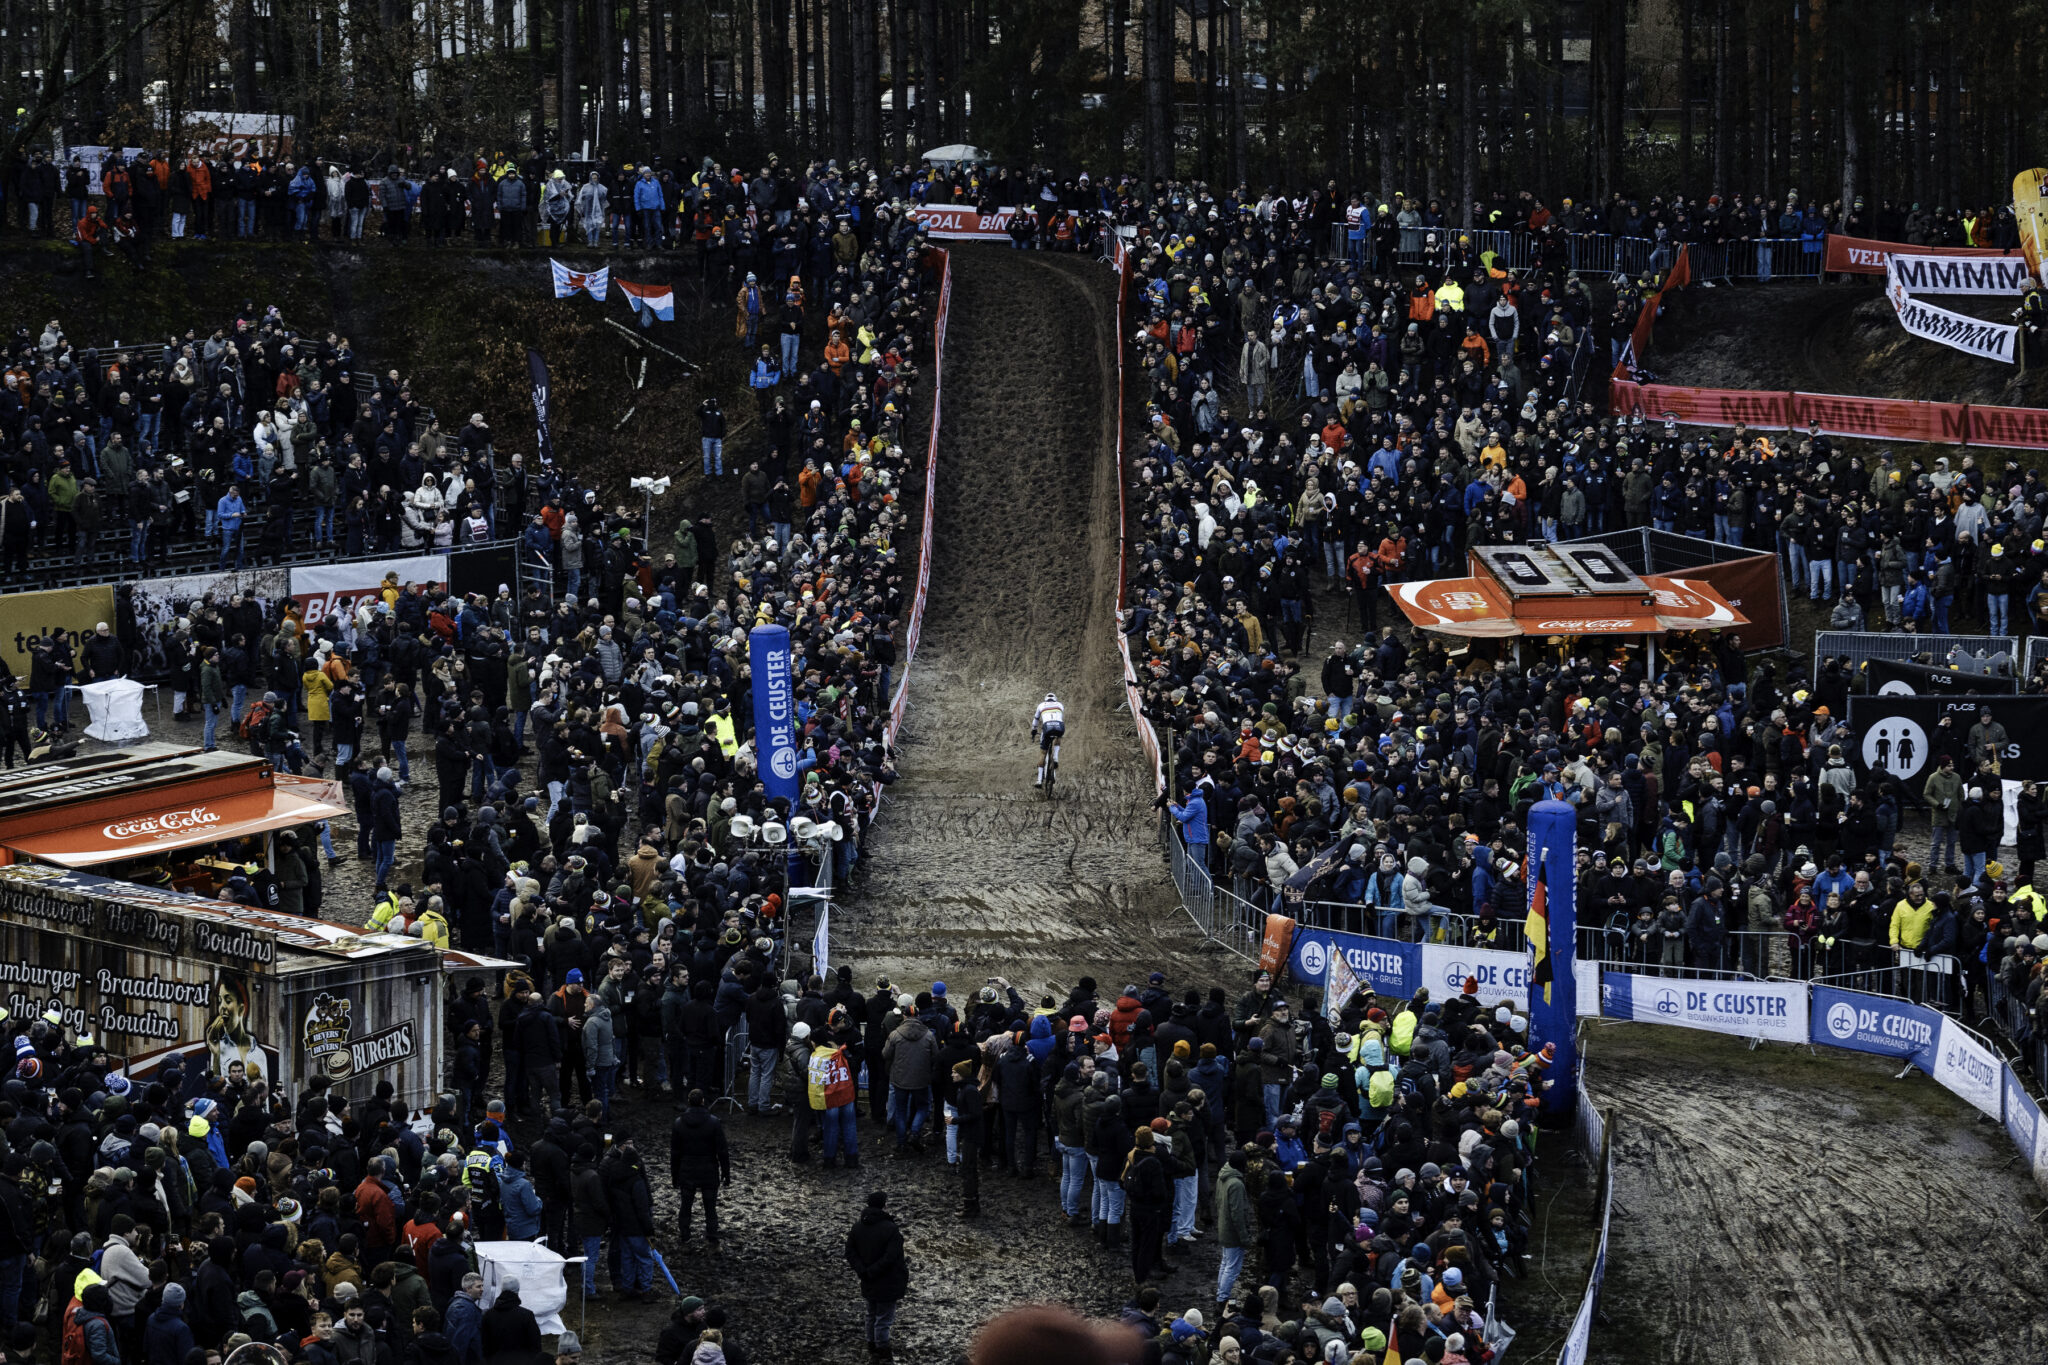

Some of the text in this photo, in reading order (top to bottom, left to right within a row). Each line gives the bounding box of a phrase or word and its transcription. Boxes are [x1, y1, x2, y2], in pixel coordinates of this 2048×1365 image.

[1537, 619, 1636, 629] Coca-Cola
[766, 649, 789, 746] DE CEUSTER
[103, 806, 220, 840] Coca-Cola
[153, 824, 217, 840] ICE COLD
[106, 902, 180, 950] Hot-Dog
[196, 921, 271, 963] Boudins
[1348, 948, 1403, 976] CEUSTER
[1477, 964, 1497, 984] DE
[97, 968, 210, 1006] Braadworst
[1380, 975, 1403, 986] GRUES
[1687, 991, 1787, 1017] DE CEUSTER
[101, 1005, 179, 1039] Boudins
[1687, 1013, 1749, 1025] BOUWKRANEN
[1758, 1018, 1787, 1028] GRUES
[1858, 1009, 1932, 1046] DE CEUSTER
[352, 1026, 411, 1073] BURGERS
[1857, 1031, 1909, 1051] BOUWKRANEN
[1959, 1046, 1994, 1086] DE CEUSTER
